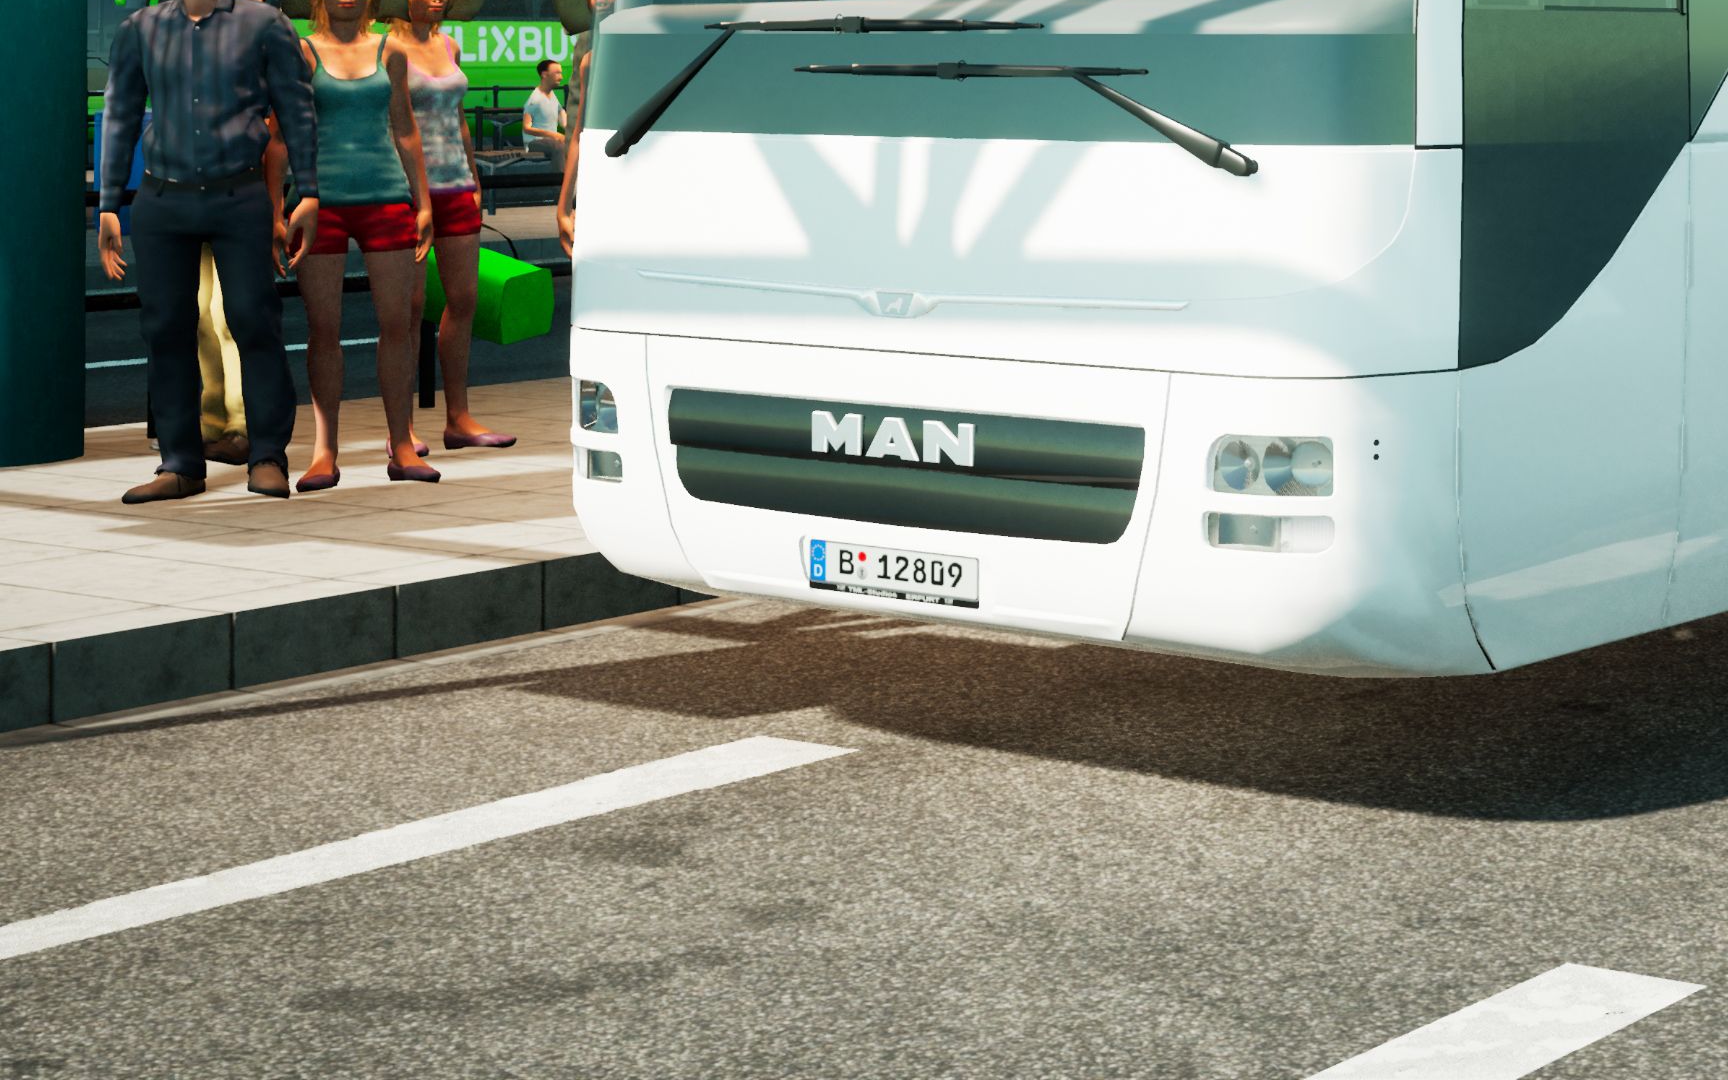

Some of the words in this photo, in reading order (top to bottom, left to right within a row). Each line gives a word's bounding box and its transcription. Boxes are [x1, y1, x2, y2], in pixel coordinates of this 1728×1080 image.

[811, 410, 976, 467] MAN
[813, 563, 824, 577] D
[839, 550, 854, 575] B
[877, 554, 963, 588] 12809
